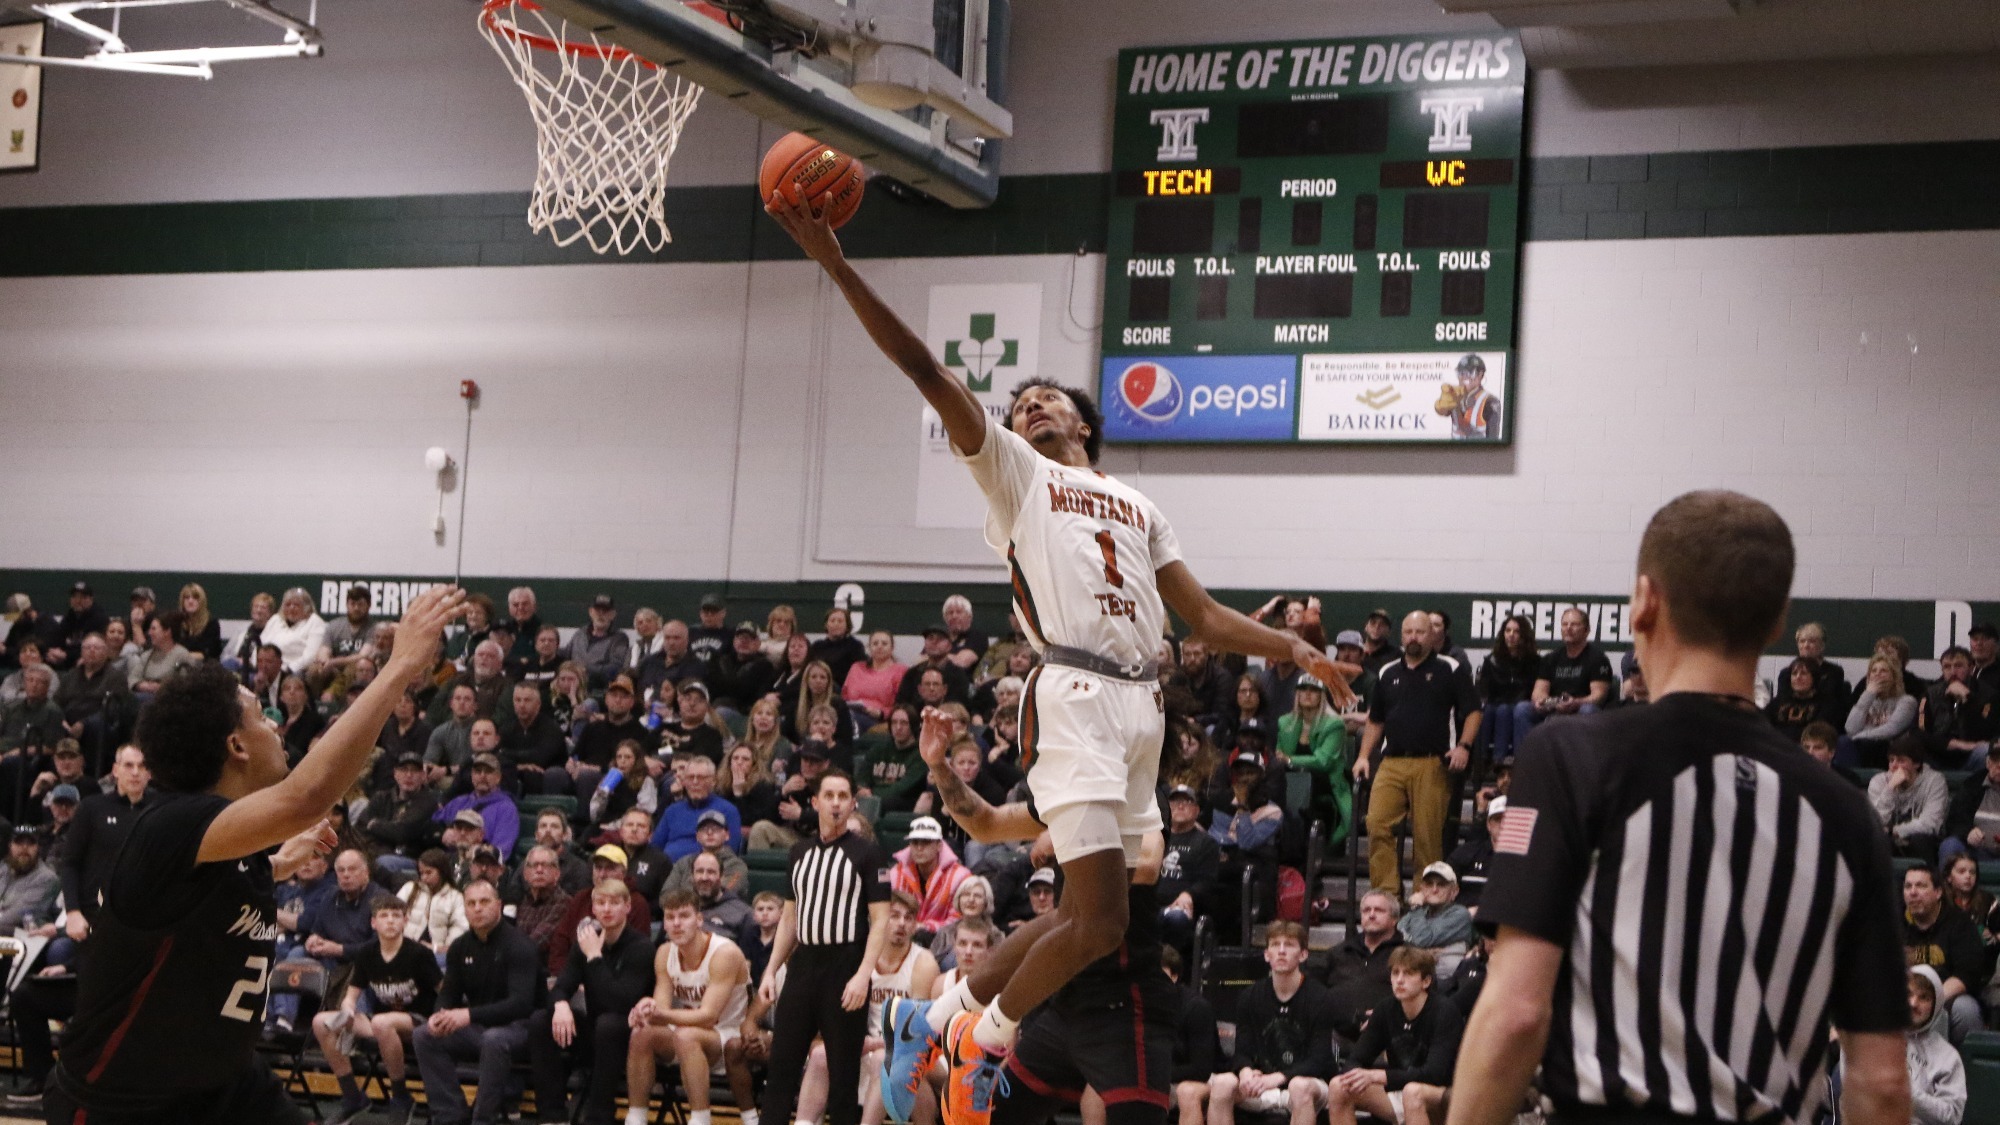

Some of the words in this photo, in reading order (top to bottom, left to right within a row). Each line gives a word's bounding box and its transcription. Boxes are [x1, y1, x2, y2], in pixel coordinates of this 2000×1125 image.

[1129, 50, 1231, 94] HOME
[1236, 48, 1283, 89] OF
[1288, 45, 1356, 87] THE
[1358, 37, 1513, 84] DIGGERS
[800, 153, 844, 190] LEGAC
[1143, 168, 1212, 195] TECH
[1426, 160, 1465, 186] WC
[1280, 178, 1337, 198] PERIOD
[1126, 258, 1176, 276] FOULS
[1194, 257, 1236, 275] T.O.L.
[1255, 255, 1315, 274] PLAYER
[1317, 254, 1358, 272] FOUL
[1377, 252, 1420, 271] T.O.L.
[1438, 251, 1491, 270] FOULS
[1122, 326, 1172, 345] SCORE
[1274, 324, 1329, 343] MATCH
[1435, 321, 1488, 341] SCORE
[1310, 362, 1321, 370] Be
[1385, 361, 1397, 369] Be
[1315, 374, 1326, 382] BE
[1327, 373, 1347, 382] SAFE
[1349, 373, 1364, 381] ON
[1366, 373, 1392, 381] YOUR
[1392, 373, 1413, 381] WAY
[1416, 372, 1443, 381] HOME
[1189, 378, 1286, 417] pepsi
[1328, 413, 1427, 430] BARRICK
[1047, 482, 1146, 534] MONTANA
[1095, 529, 1124, 589] 1
[1094, 593, 1136, 622] TEH
[220, 956, 272, 1022] 2
